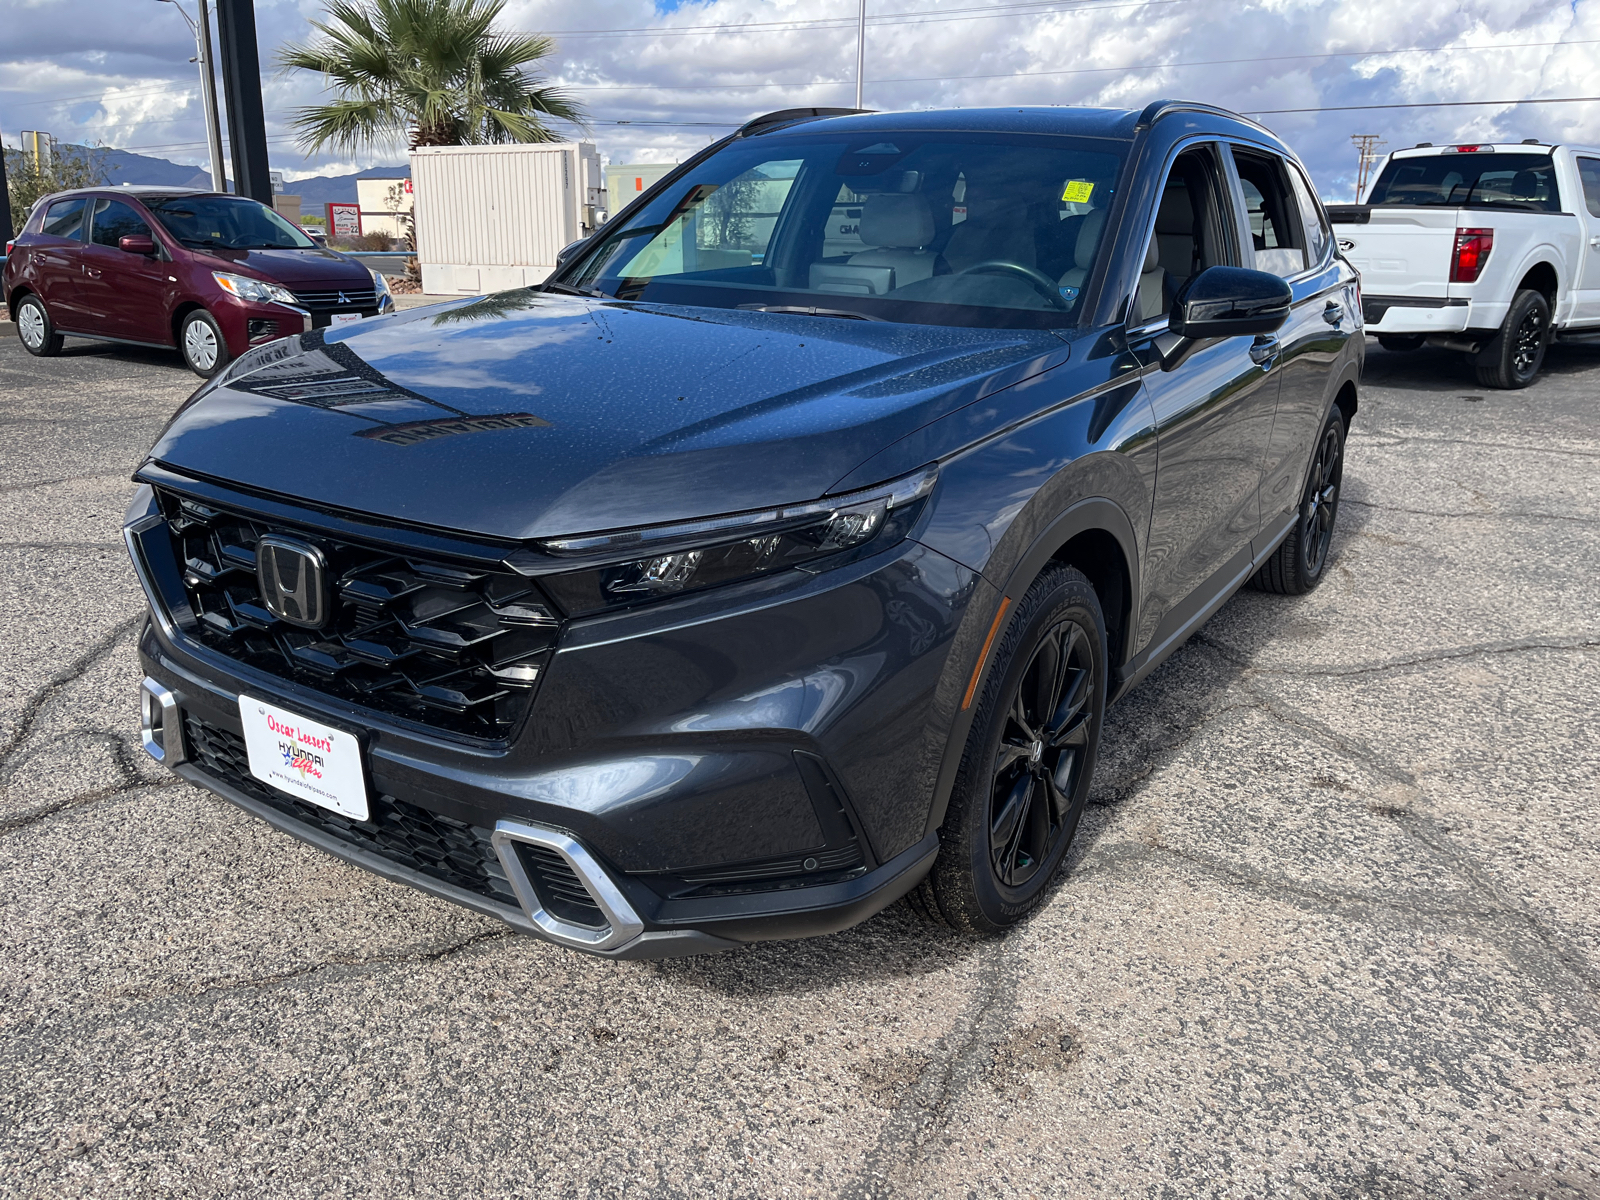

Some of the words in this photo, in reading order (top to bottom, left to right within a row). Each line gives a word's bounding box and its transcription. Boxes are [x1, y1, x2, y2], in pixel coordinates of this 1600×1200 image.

[840, 225, 860, 234] GM
[267, 714, 295, 738] Oscar
[297, 727, 331, 753] Leeser's
[278, 741, 324, 767] HYUNDAI
